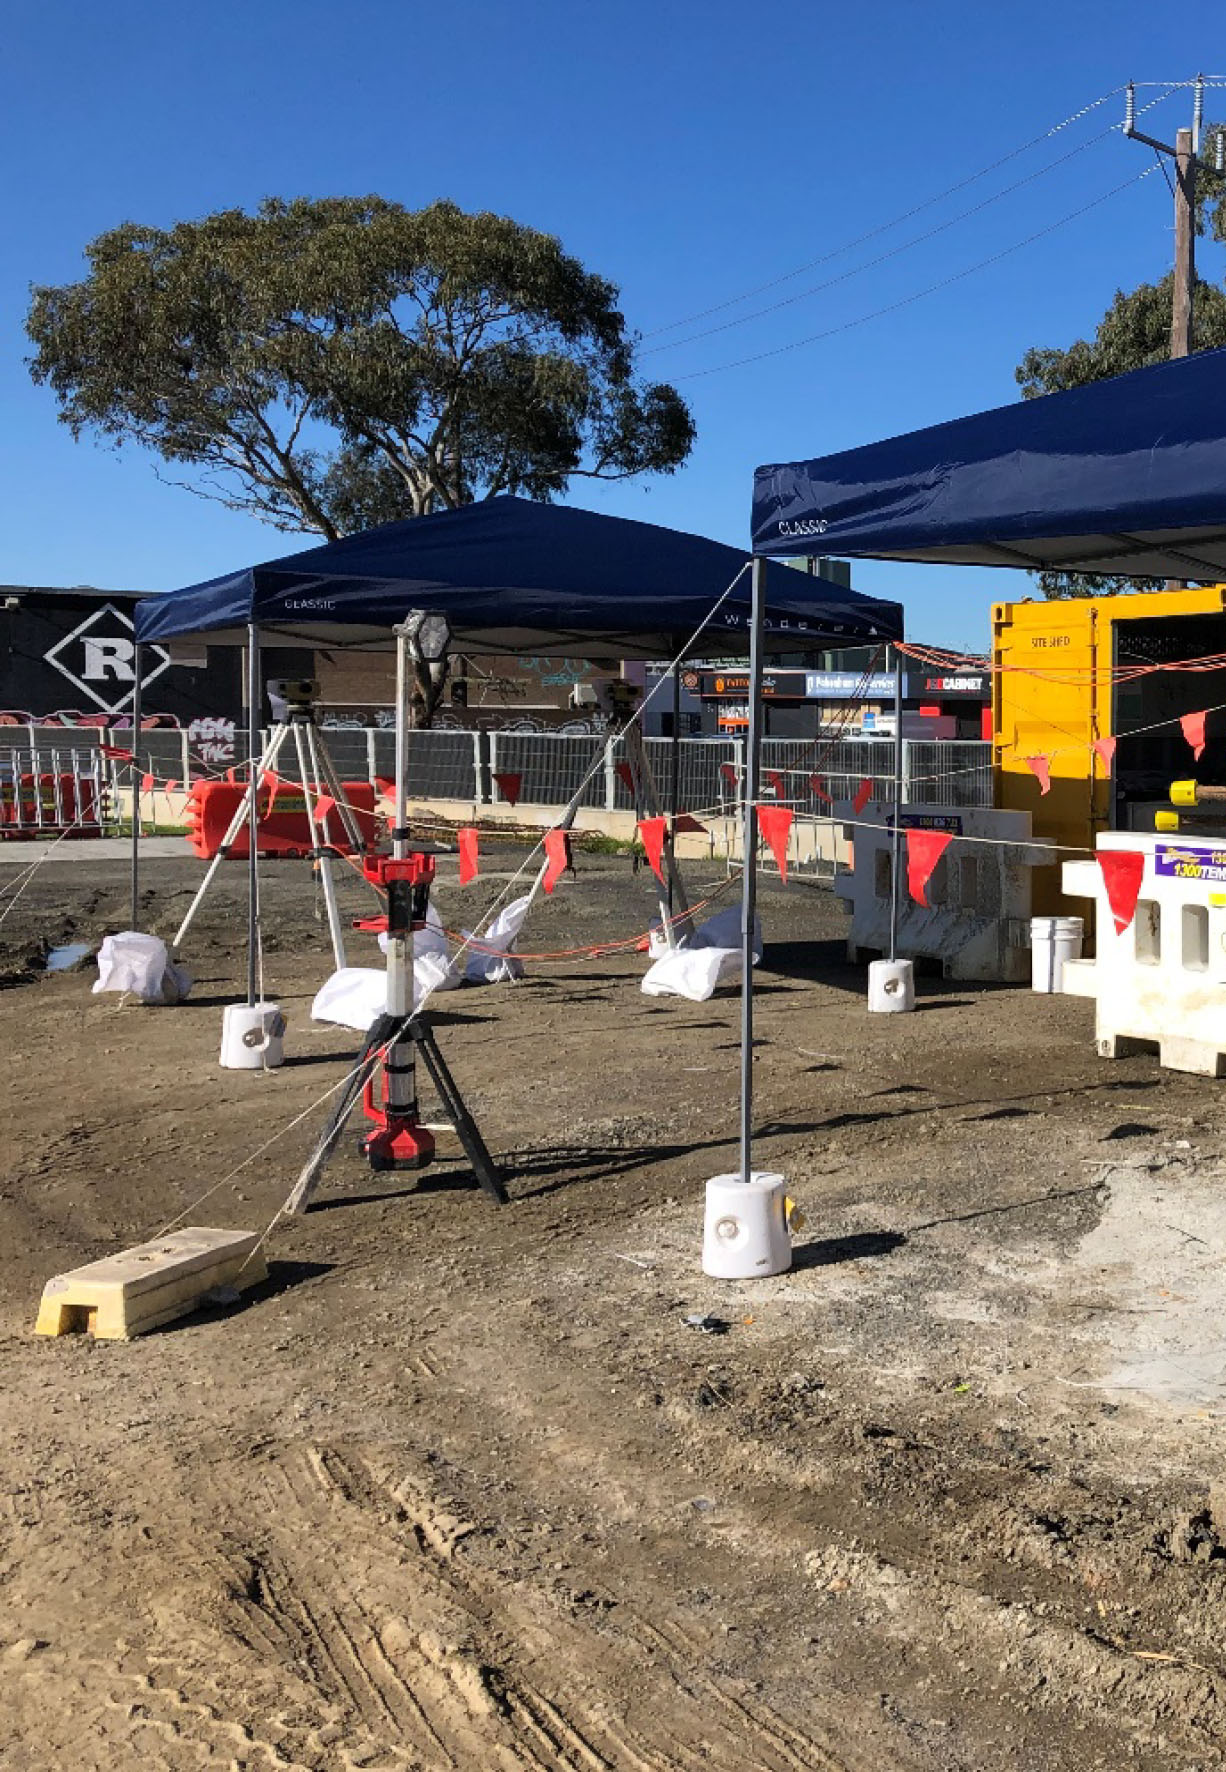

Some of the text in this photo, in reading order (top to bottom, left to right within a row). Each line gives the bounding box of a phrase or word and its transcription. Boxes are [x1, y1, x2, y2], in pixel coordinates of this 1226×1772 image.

[779, 519, 828, 535] CLASSIC
[284, 599, 336, 610] CLASSIC
[80, 635, 136, 681] R
